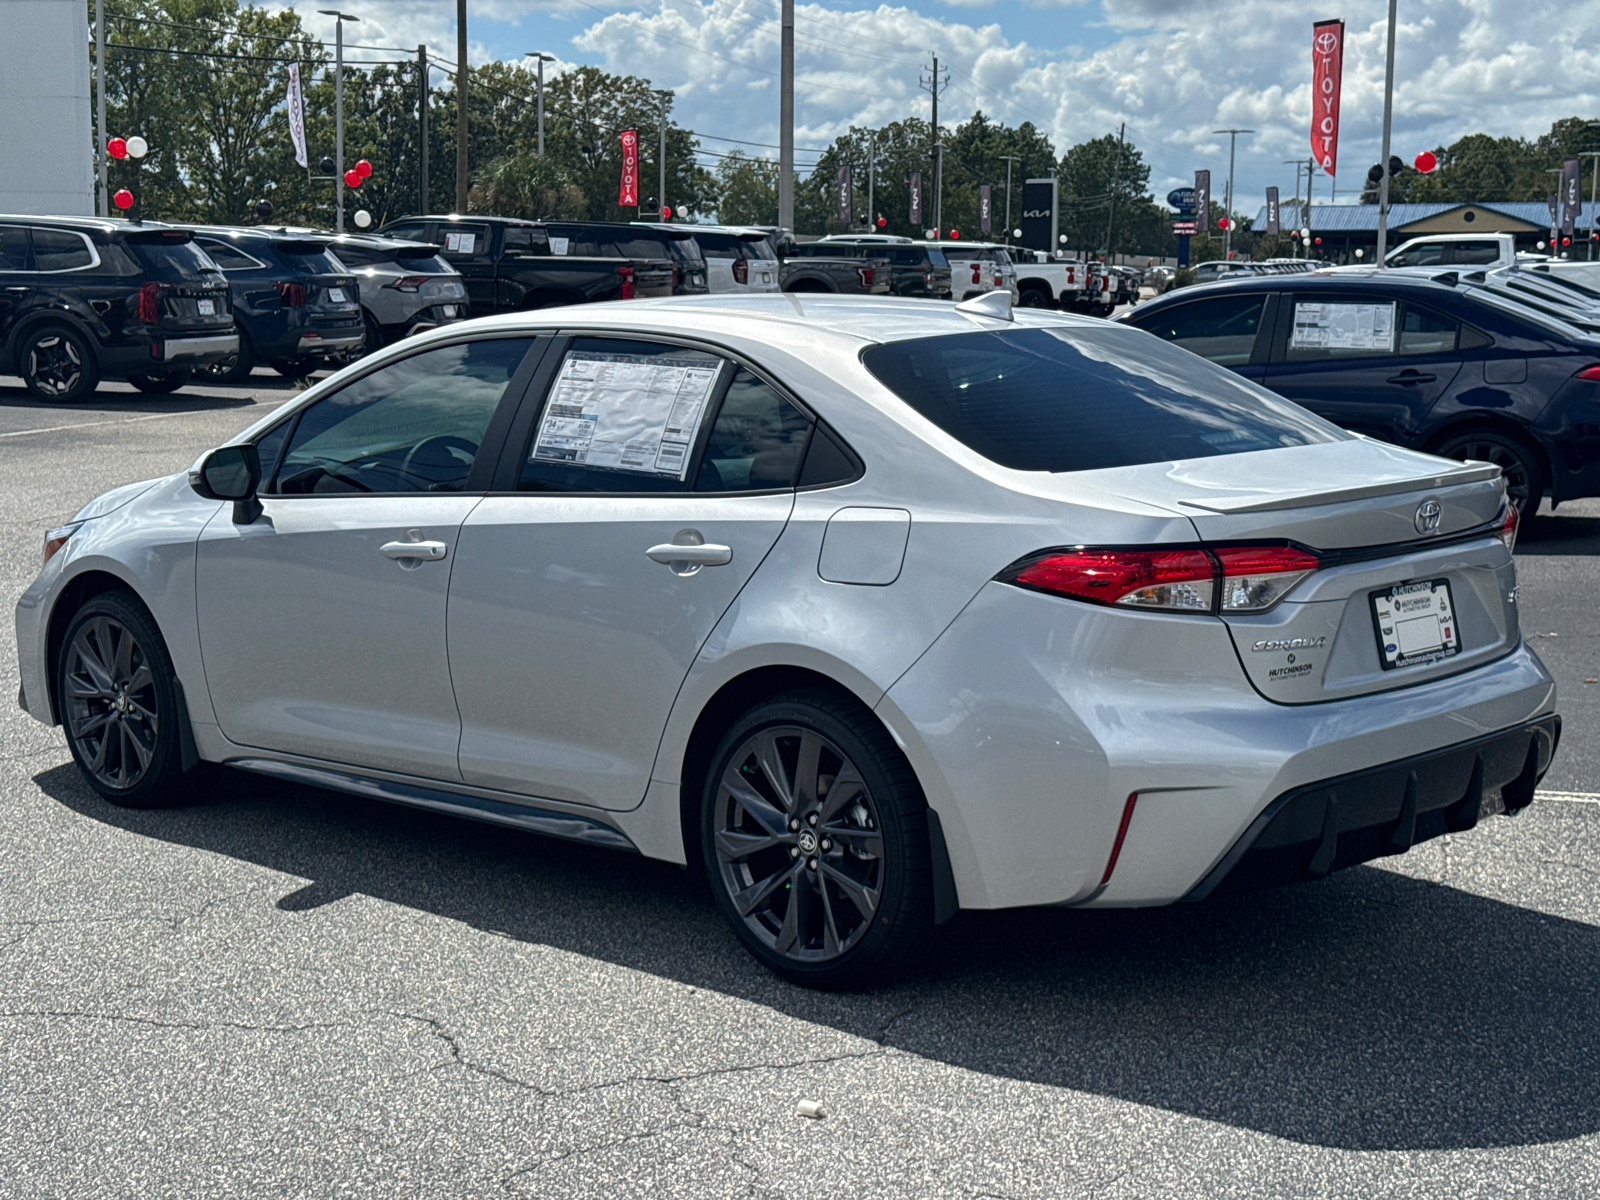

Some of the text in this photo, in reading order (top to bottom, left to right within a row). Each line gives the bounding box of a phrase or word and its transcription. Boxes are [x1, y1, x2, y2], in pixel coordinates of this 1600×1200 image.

[1320, 57, 1334, 170] TOYOTA
[624, 146, 635, 204] TOYOTA
[1023, 209, 1050, 218] KIA
[202, 281, 215, 289] KIA
[1252, 637, 1326, 652] COROLLA
[1269, 663, 1313, 676] HUTCHINSON
[1269, 670, 1312, 682] AUTOMOTIVE GROUP
